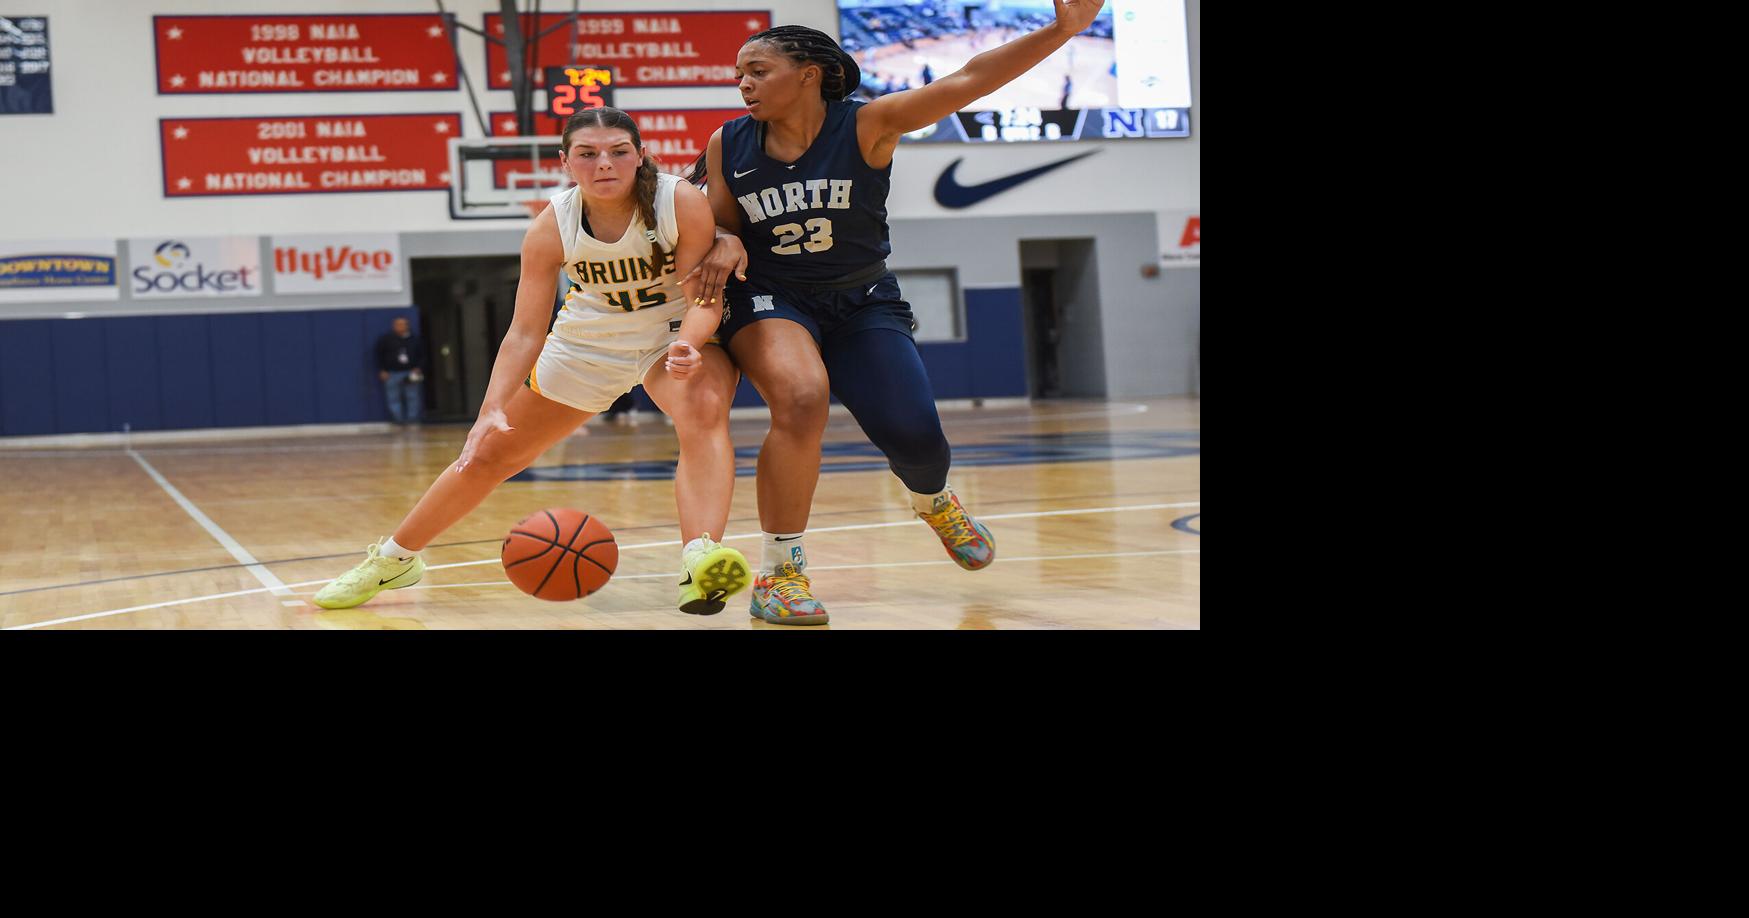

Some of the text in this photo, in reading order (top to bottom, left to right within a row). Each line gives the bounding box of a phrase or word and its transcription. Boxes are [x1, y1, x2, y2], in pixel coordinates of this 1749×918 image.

[251, 24, 360, 41] 1998 NAIA
[577, 18, 682, 34] 1999 NAIA
[241, 47, 380, 64] VOLLEYBALL
[199, 69, 419, 87] NATIONAL CHAMPION
[552, 84, 605, 115] 25
[257, 121, 367, 140] 2001 NAIA
[639, 115, 687, 131] NAIA
[1106, 109, 1141, 135] N
[248, 145, 386, 164] VOLLEYBALL
[205, 169, 426, 190] NATIONAL CHAMPION
[738, 179, 853, 224] NORTH
[771, 217, 834, 255] 23
[133, 264, 255, 293] Socket
[601, 282, 667, 312] 45
[752, 295, 775, 312] N
